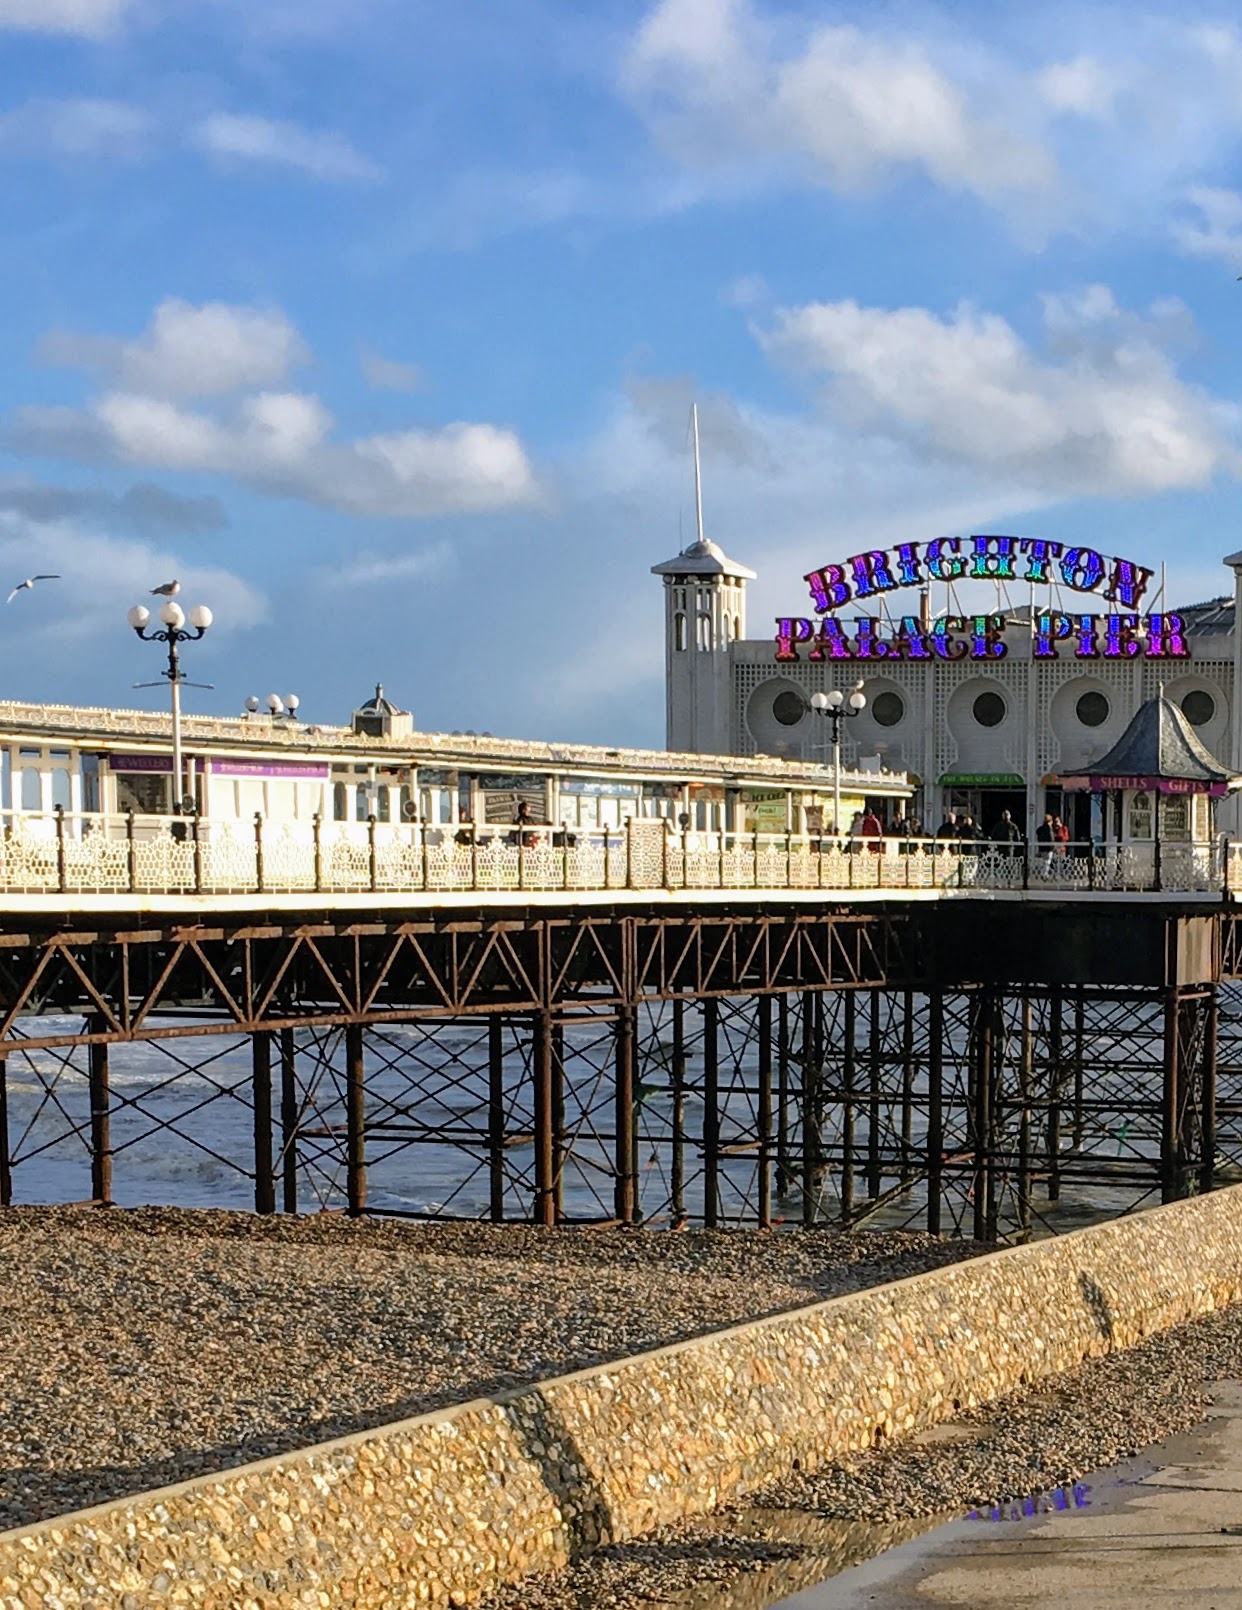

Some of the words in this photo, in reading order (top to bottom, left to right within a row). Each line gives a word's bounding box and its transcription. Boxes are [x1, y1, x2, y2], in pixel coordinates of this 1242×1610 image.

[804, 535, 1154, 614] BRIGHTON
[774, 614, 1007, 662] PALACE
[1034, 613, 1191, 661] PIER
[1100, 776, 1148, 789] SHELLS
